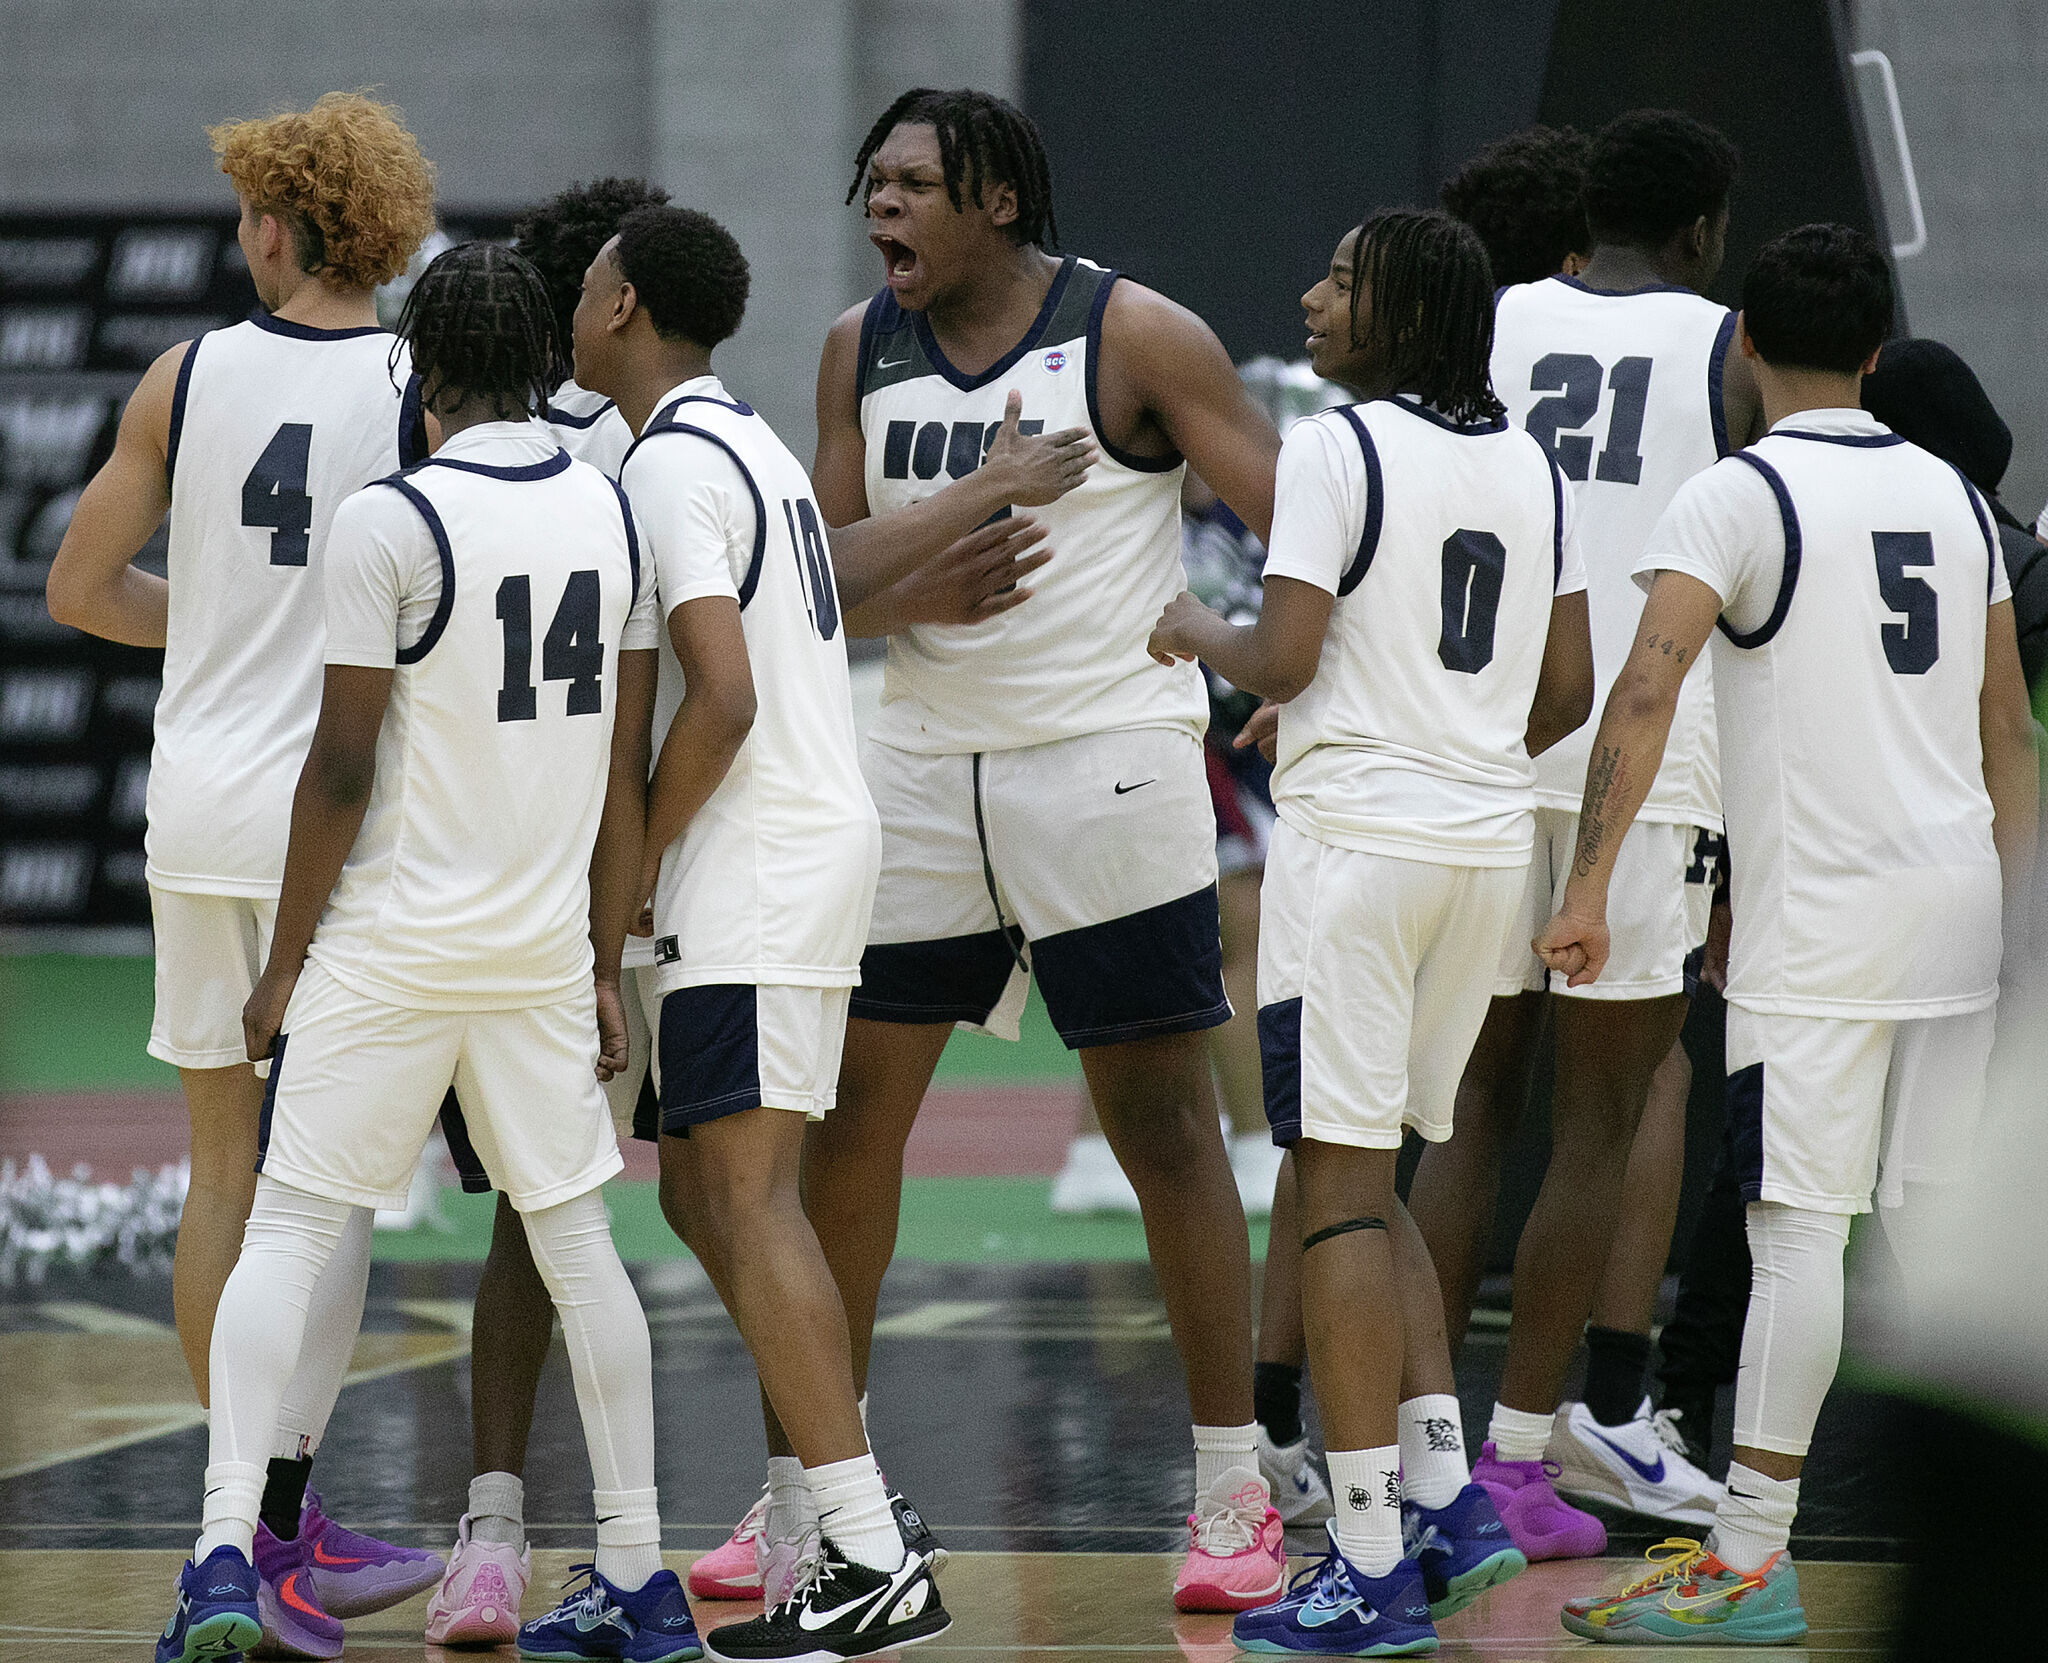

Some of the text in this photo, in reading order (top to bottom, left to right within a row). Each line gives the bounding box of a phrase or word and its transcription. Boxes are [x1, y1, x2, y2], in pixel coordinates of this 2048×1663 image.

[1045, 356, 1065, 367] SCC
[1525, 352, 1653, 485] 21
[241, 423, 312, 566] 4
[782, 498, 838, 640] 10
[1437, 528, 1506, 674] 0
[1871, 531, 1939, 674] 5
[496, 569, 604, 722] 14
[1648, 633, 1687, 663] 444
[903, 1600, 914, 1616] 2
